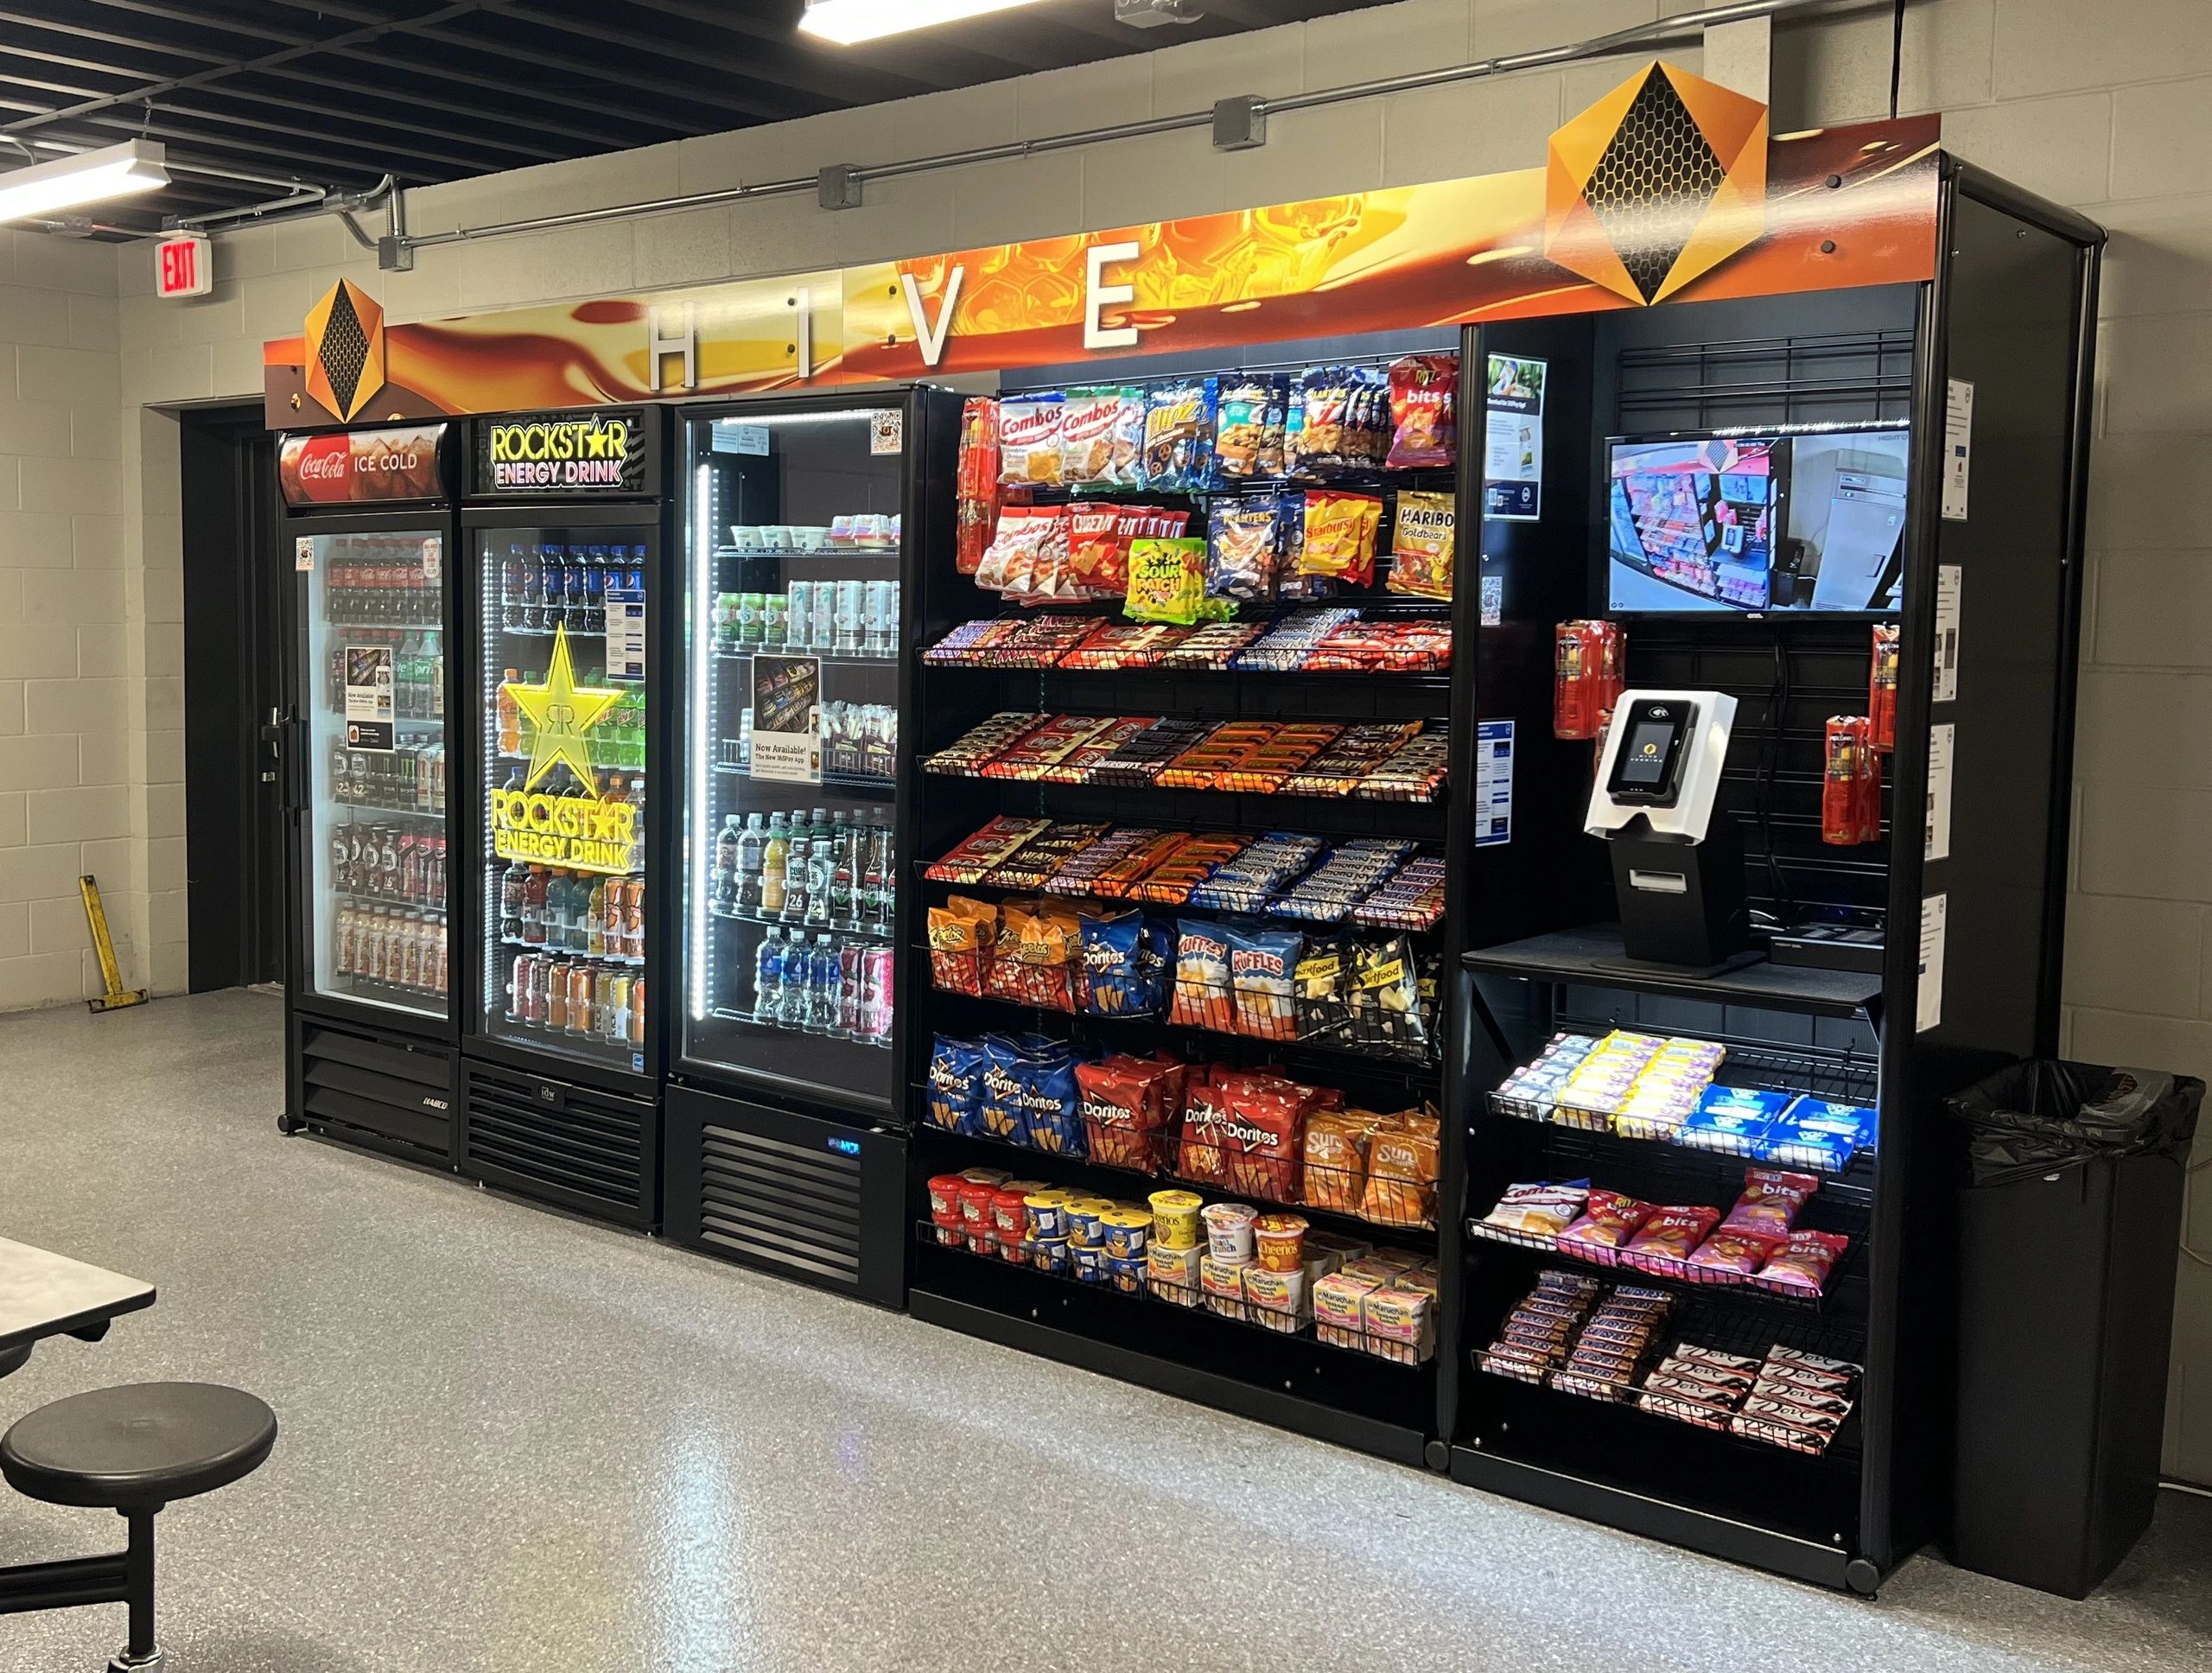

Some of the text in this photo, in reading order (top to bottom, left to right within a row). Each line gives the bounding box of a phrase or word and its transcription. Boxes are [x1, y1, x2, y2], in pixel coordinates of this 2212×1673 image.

[162, 241, 195, 291] EXIT
[1407, 390, 1440, 404] bits
[1001, 406, 1064, 436] Combos
[1063, 400, 1119, 432] Combos
[354, 453, 417, 473] ICE COLD
[496, 460, 622, 485] ENERGY DRINK
[1402, 508, 1454, 527] HARIBO
[1402, 527, 1447, 541] Goldbears
[1139, 565, 1179, 578] SOUR
[1137, 578, 1181, 593] PATCH
[755, 743, 806, 754] Now Available!
[497, 828, 630, 868] ENERGY DRINK
[790, 867, 805, 875] CORE
[789, 894, 803, 907] 26
[1233, 950, 1283, 974] RUFFLES
[930, 1066, 969, 1090] Doritos
[984, 1072, 1021, 1093] Dorito
[423, 1097, 448, 1110] HABCO
[1022, 1092, 1061, 1110] Doritos
[1084, 1101, 1131, 1119] Doritos
[1228, 1123, 1278, 1146] Doritos
[1377, 1144, 1415, 1162] Sun
[1762, 1183, 1800, 1198] bits
[1662, 1216, 1700, 1228] bits
[1260, 1241, 1298, 1256] Cheerios
[1790, 1244, 1829, 1256] bits
[1209, 1263, 1237, 1275] Maruchan
[1253, 1275, 1284, 1286] Maruchan
[1323, 1292, 1356, 1305] Maruchan
[1374, 1303, 1409, 1316] Maruchan
[1683, 1345, 1738, 1363] Dove
[1778, 1346, 1835, 1366] Dove
[1668, 1360, 1723, 1378] Dove
[1770, 1364, 1827, 1384] Dove
[1652, 1377, 1709, 1395] Dove
[1762, 1383, 1821, 1402] Dove
[1753, 1399, 1813, 1420] Dove
